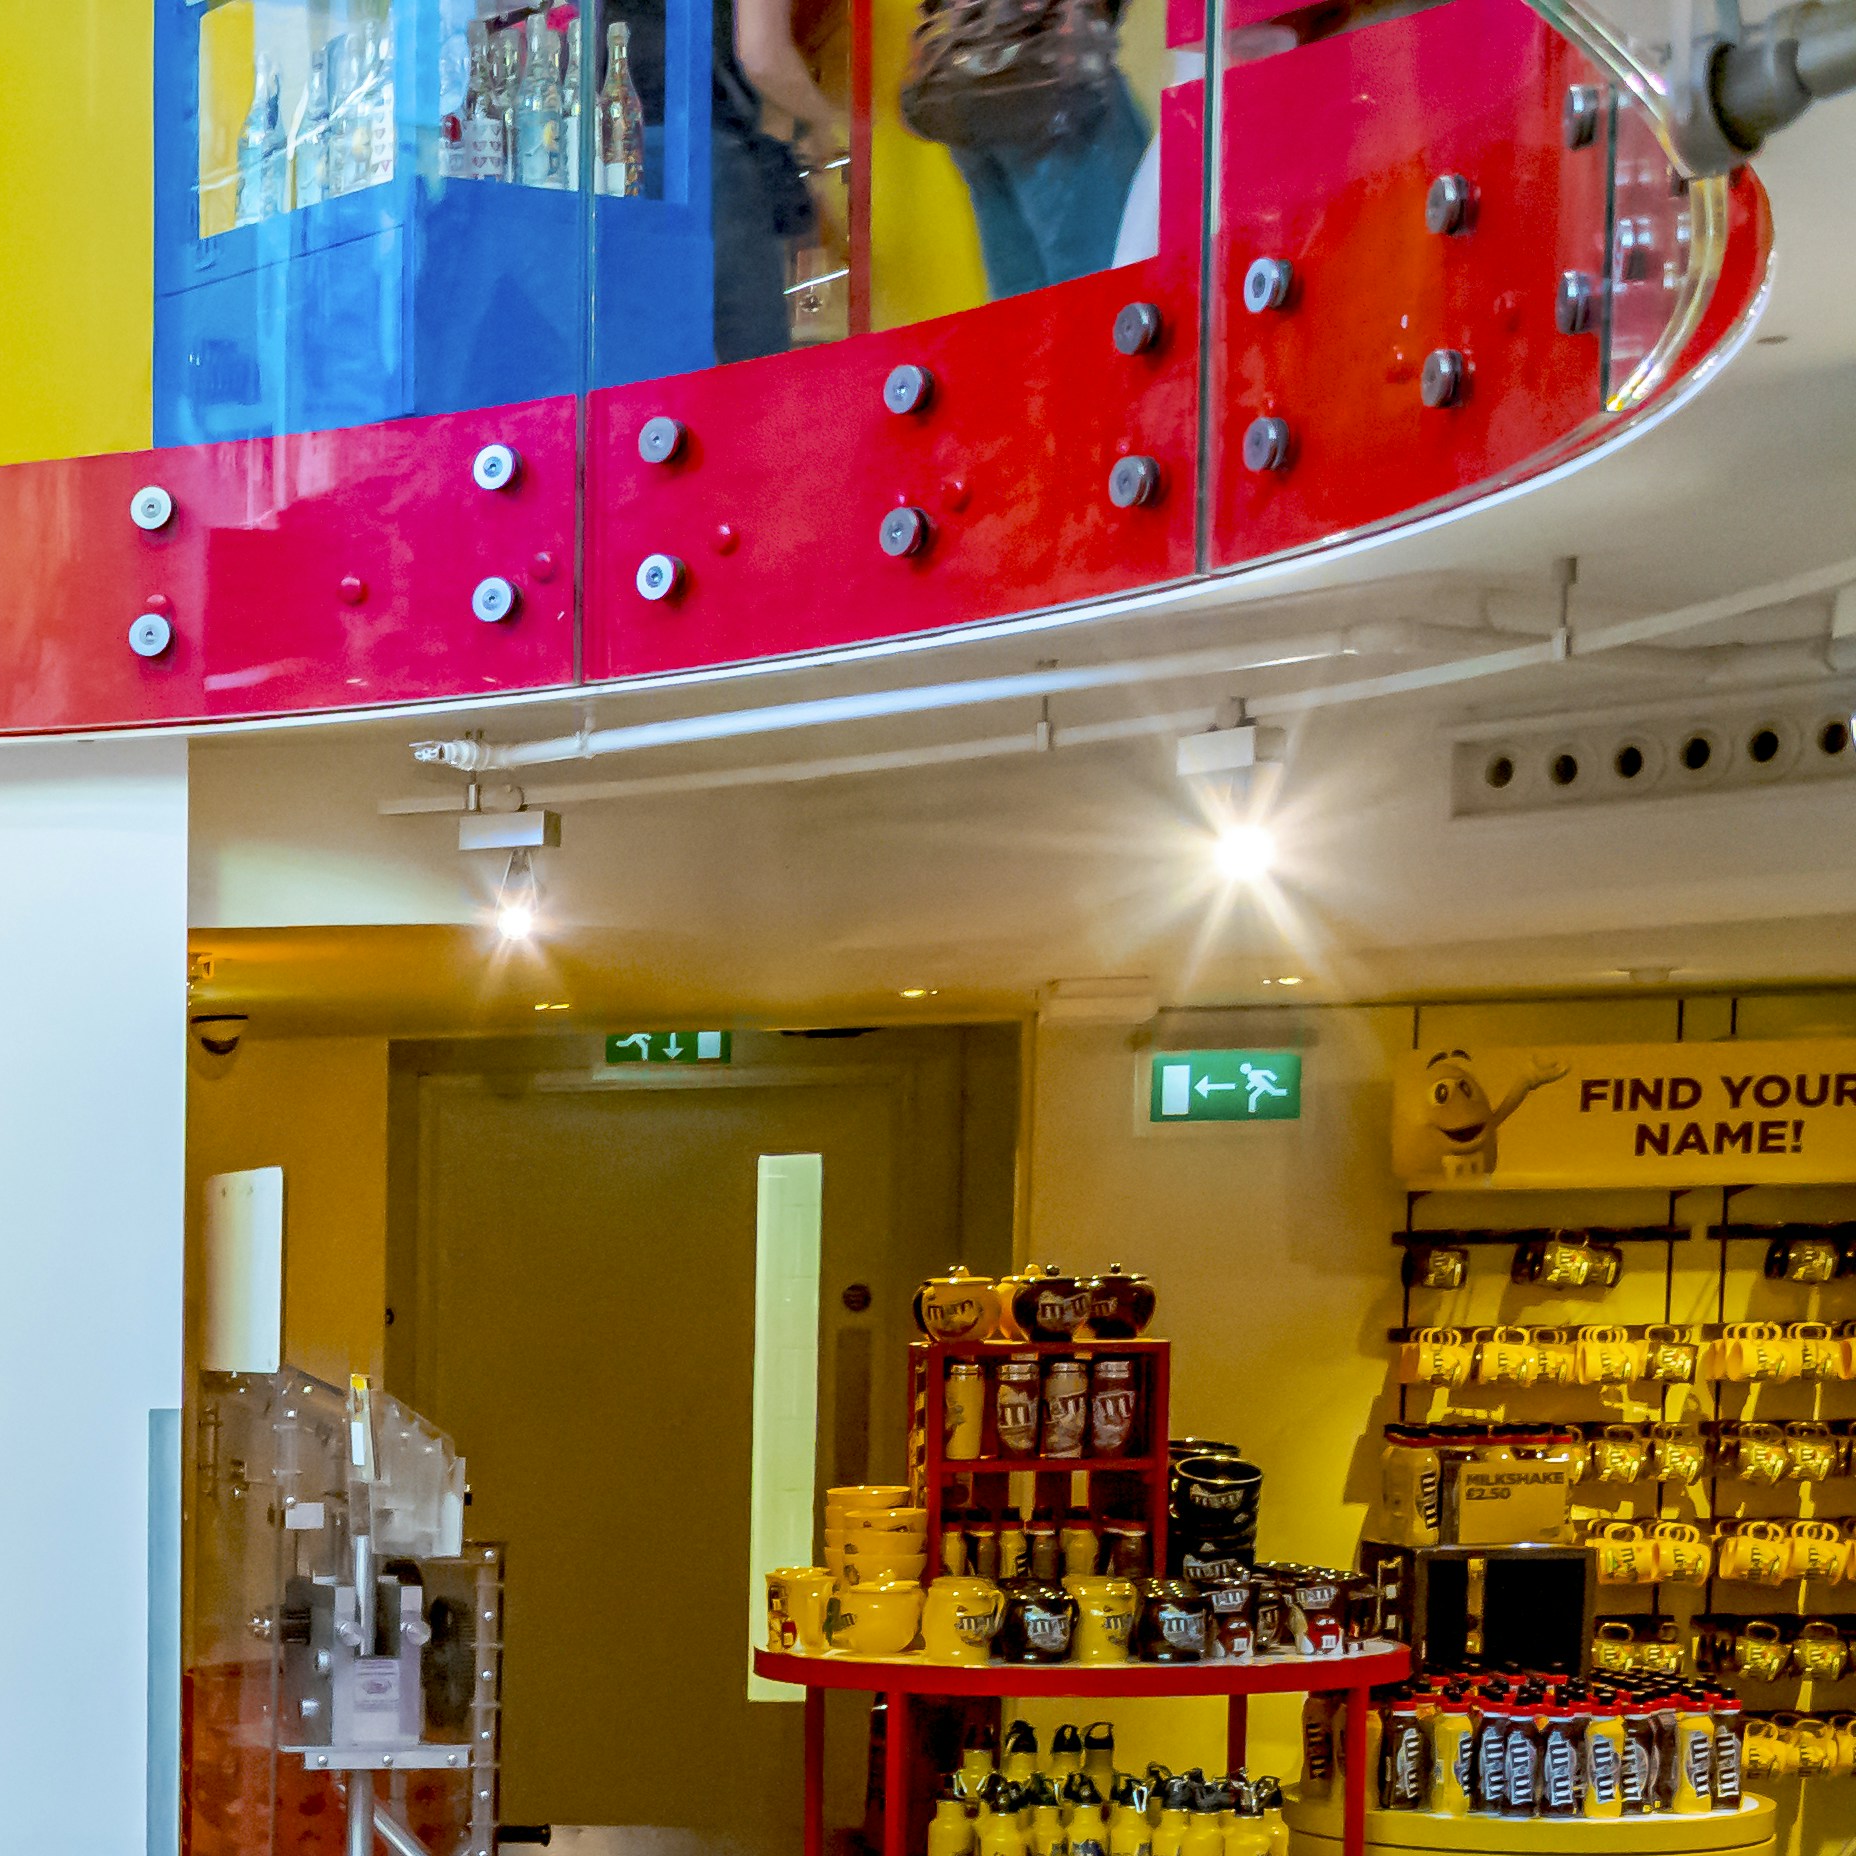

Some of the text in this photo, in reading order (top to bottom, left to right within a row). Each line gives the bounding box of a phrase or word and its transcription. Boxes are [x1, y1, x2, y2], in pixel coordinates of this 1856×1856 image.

[1579, 1073, 1856, 1112] FIND YOUR
[1634, 1120, 1806, 1156] NAME!
[1465, 1471, 1565, 1486] MILKSHAKE
